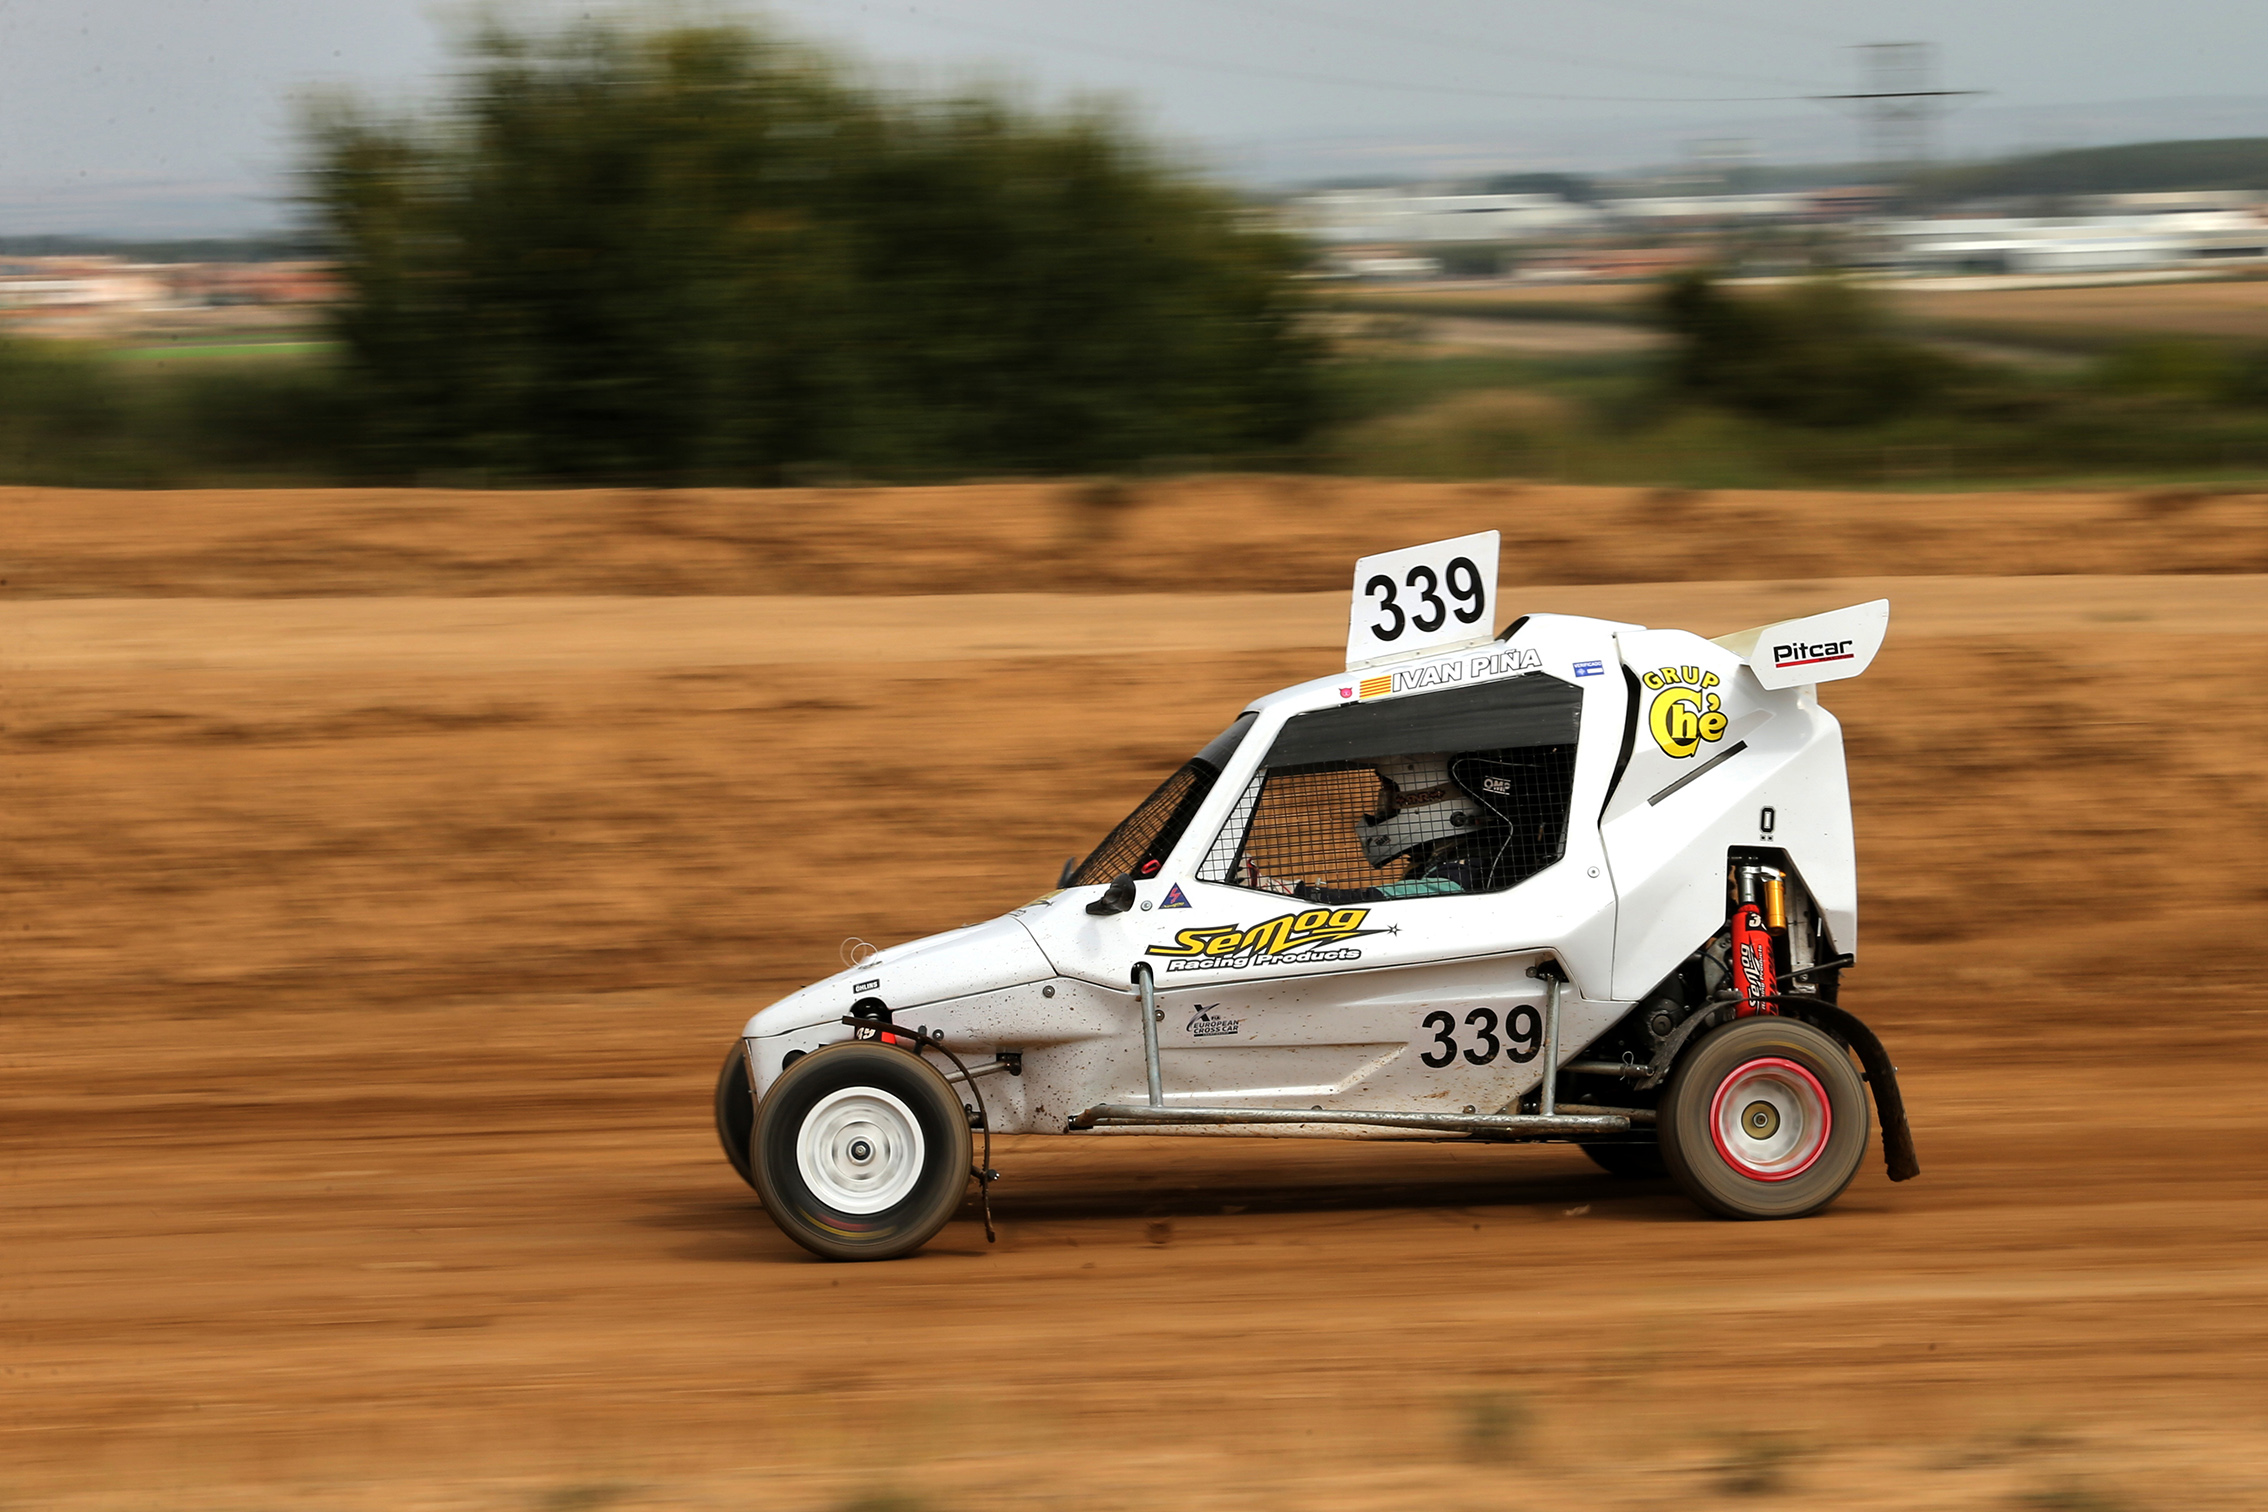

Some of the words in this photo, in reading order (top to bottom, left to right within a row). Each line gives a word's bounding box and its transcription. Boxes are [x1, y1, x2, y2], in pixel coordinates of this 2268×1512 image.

[1364, 556, 1485, 642] 339
[1773, 639, 1853, 663] Pitcar
[1392, 659, 1463, 693] IVAN
[1470, 648, 1542, 678] PIÑA
[1642, 665, 1721, 691] GRUP
[1166, 954, 1251, 972] Racing
[1253, 948, 1362, 966] Products
[1193, 1020, 1239, 1029] EUROPEAN
[1420, 1004, 1543, 1068] 339
